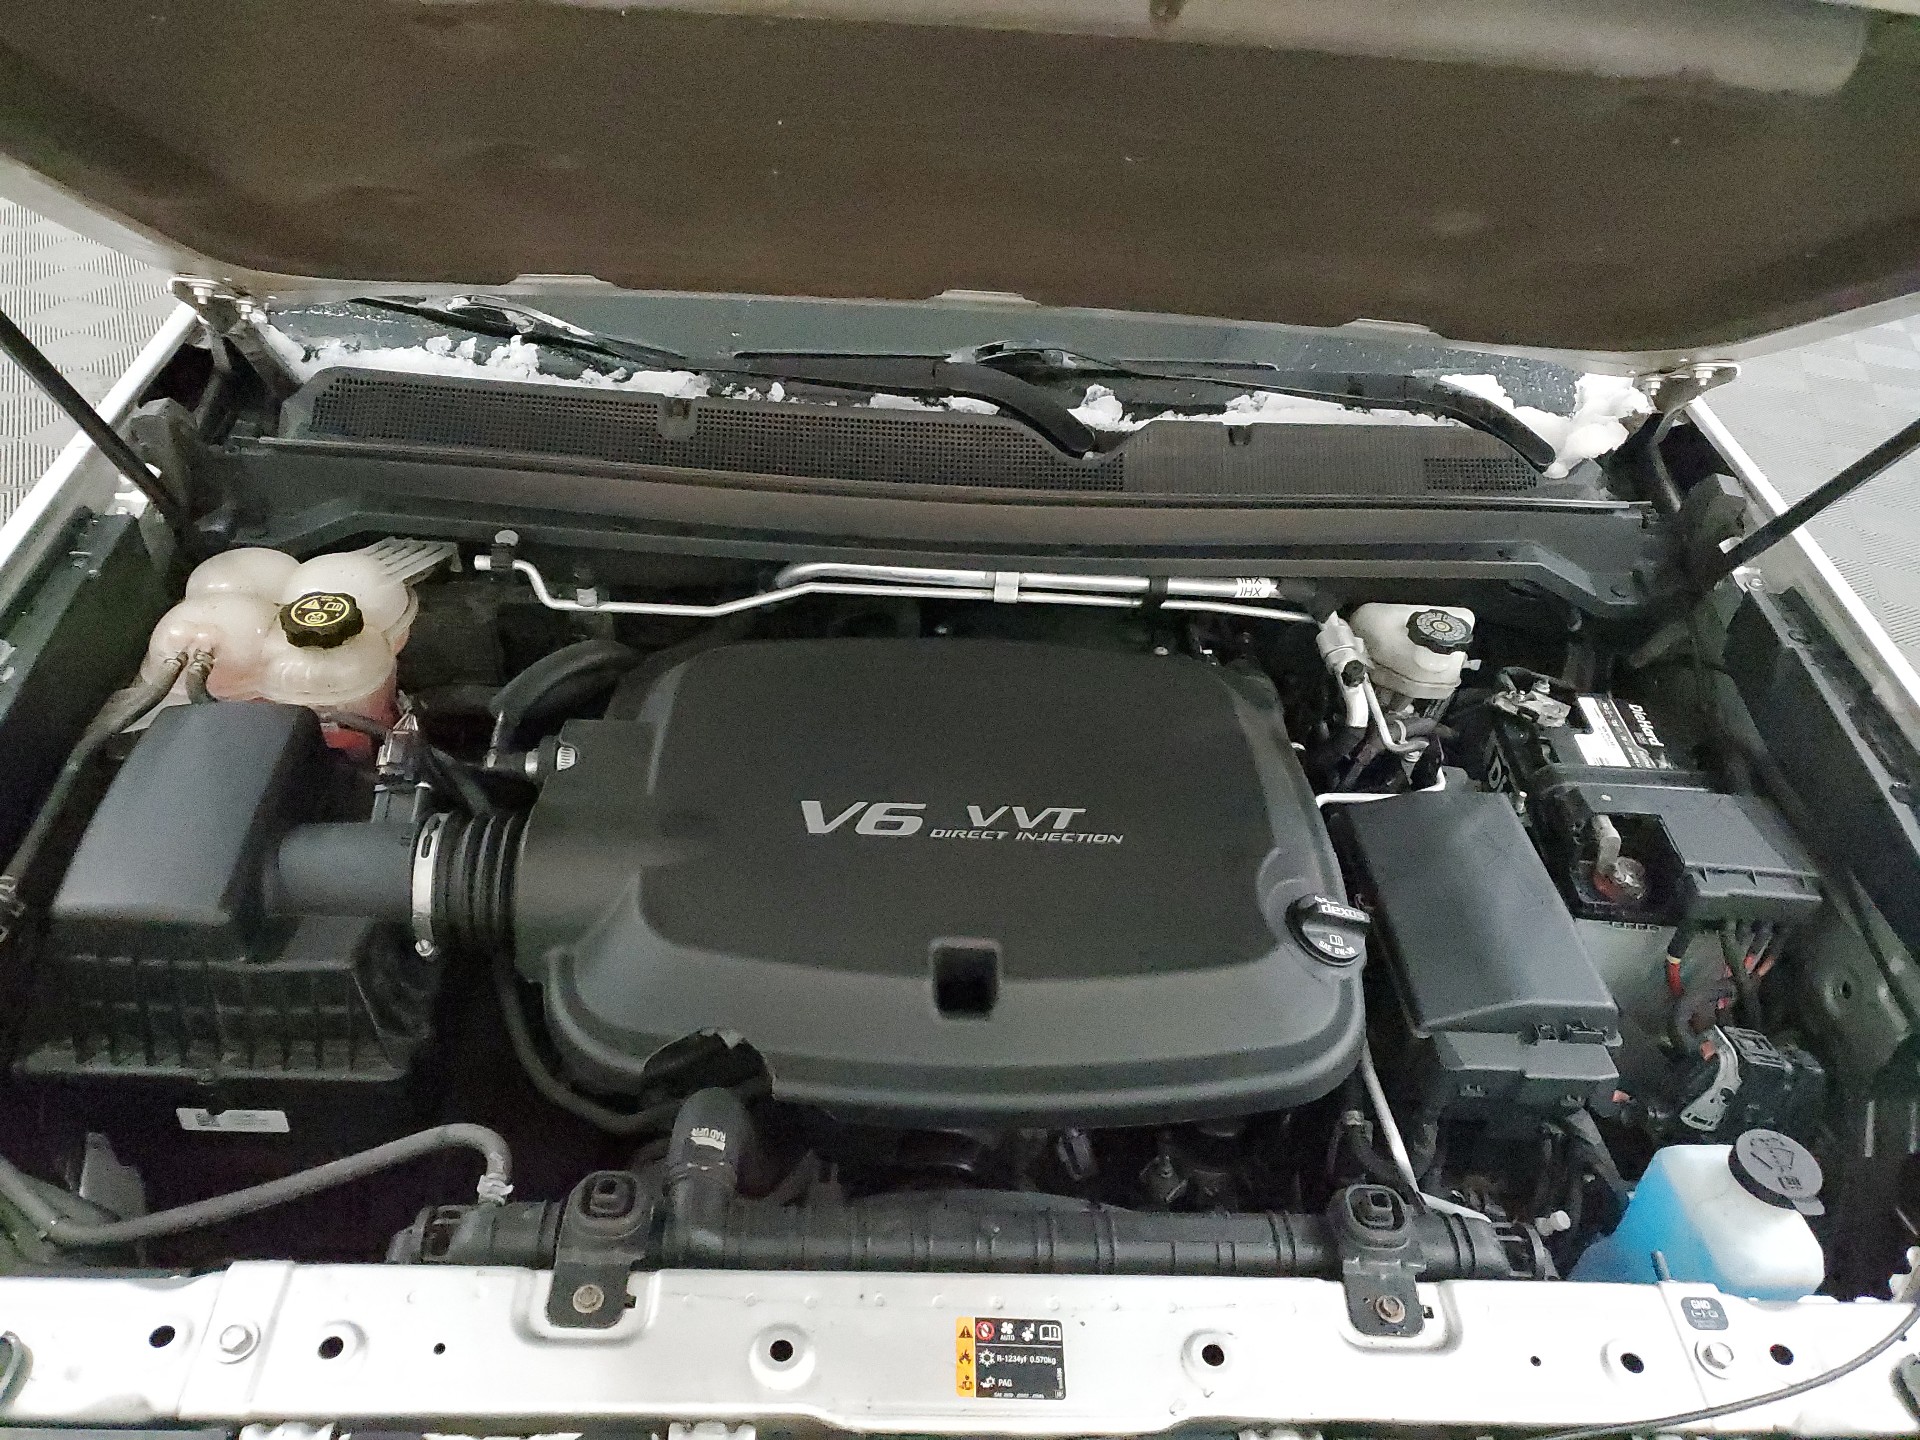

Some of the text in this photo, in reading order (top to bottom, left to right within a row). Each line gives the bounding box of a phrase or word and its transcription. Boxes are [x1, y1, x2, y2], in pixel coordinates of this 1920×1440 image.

[1239, 587, 1262, 597] IHX
[1628, 703, 1665, 748] DieHard
[801, 800, 1087, 837] V6 VVT
[929, 828, 1124, 844] DIRECT INJECTION
[1321, 903, 1366, 921] dexos
[1318, 940, 1356, 956] SAE 5W-30
[710, 1128, 727, 1143] RAD
[1690, 1299, 1711, 1310] GND
[996, 1354, 1057, 1366] R-1234yf 0.570kg
